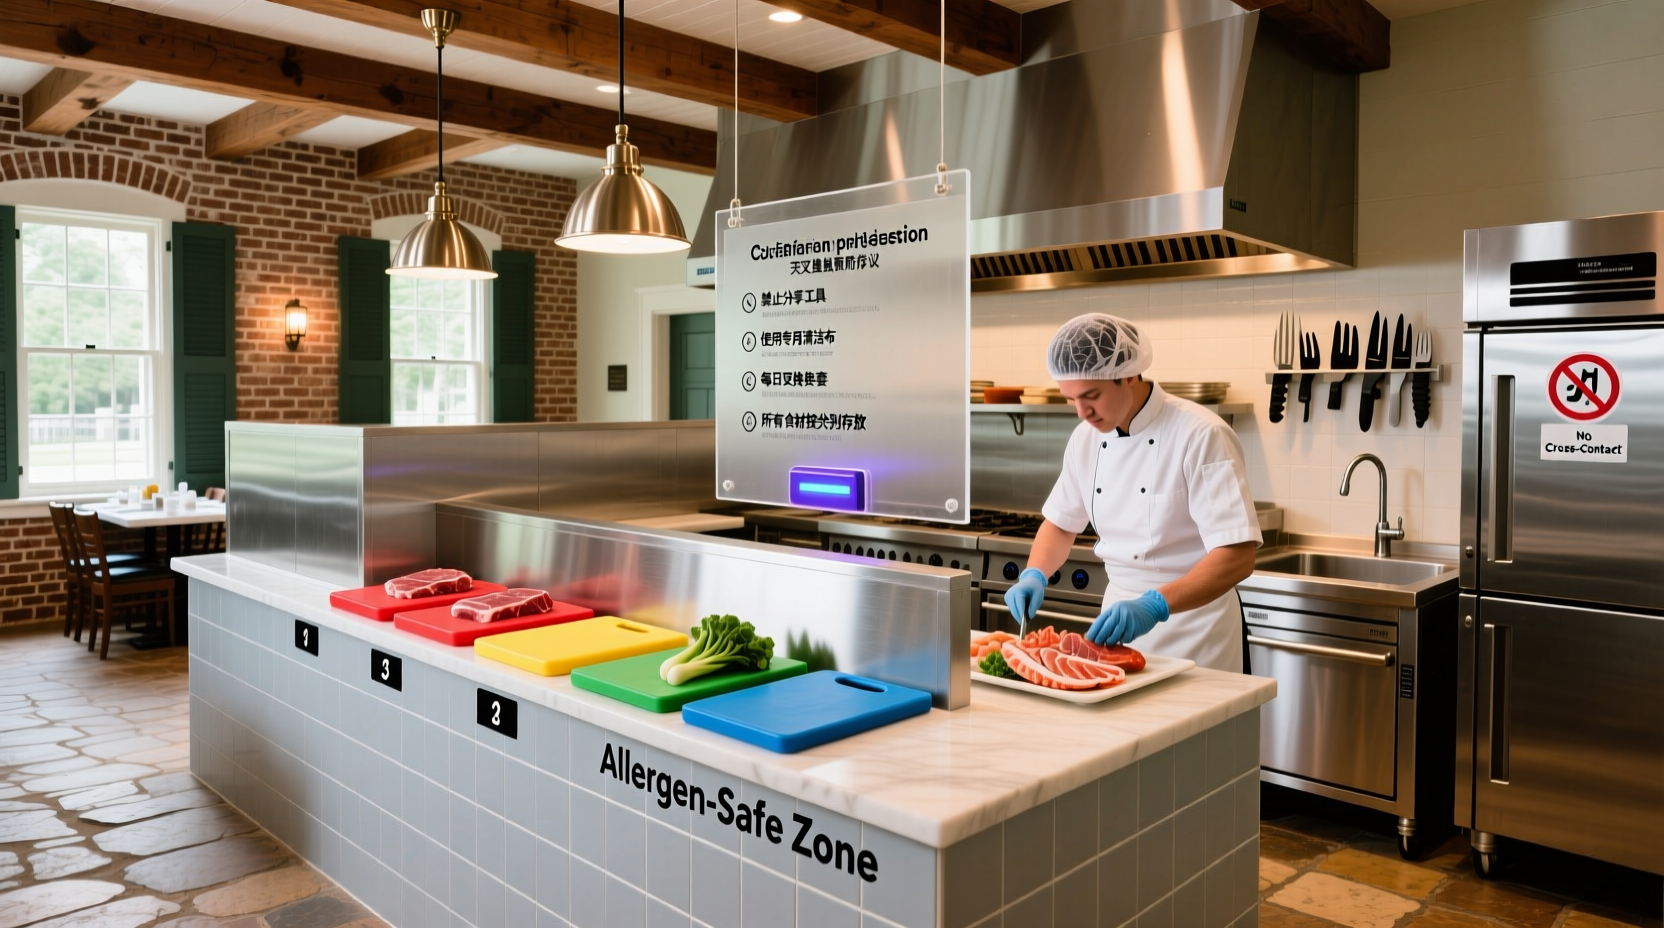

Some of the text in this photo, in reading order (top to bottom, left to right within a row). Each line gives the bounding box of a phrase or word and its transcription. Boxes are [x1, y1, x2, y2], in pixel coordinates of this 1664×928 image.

[1576, 430, 1592, 441] No
[381, 658, 390, 680] 3
[600, 743, 879, 883] Allergen-Safe Zone
